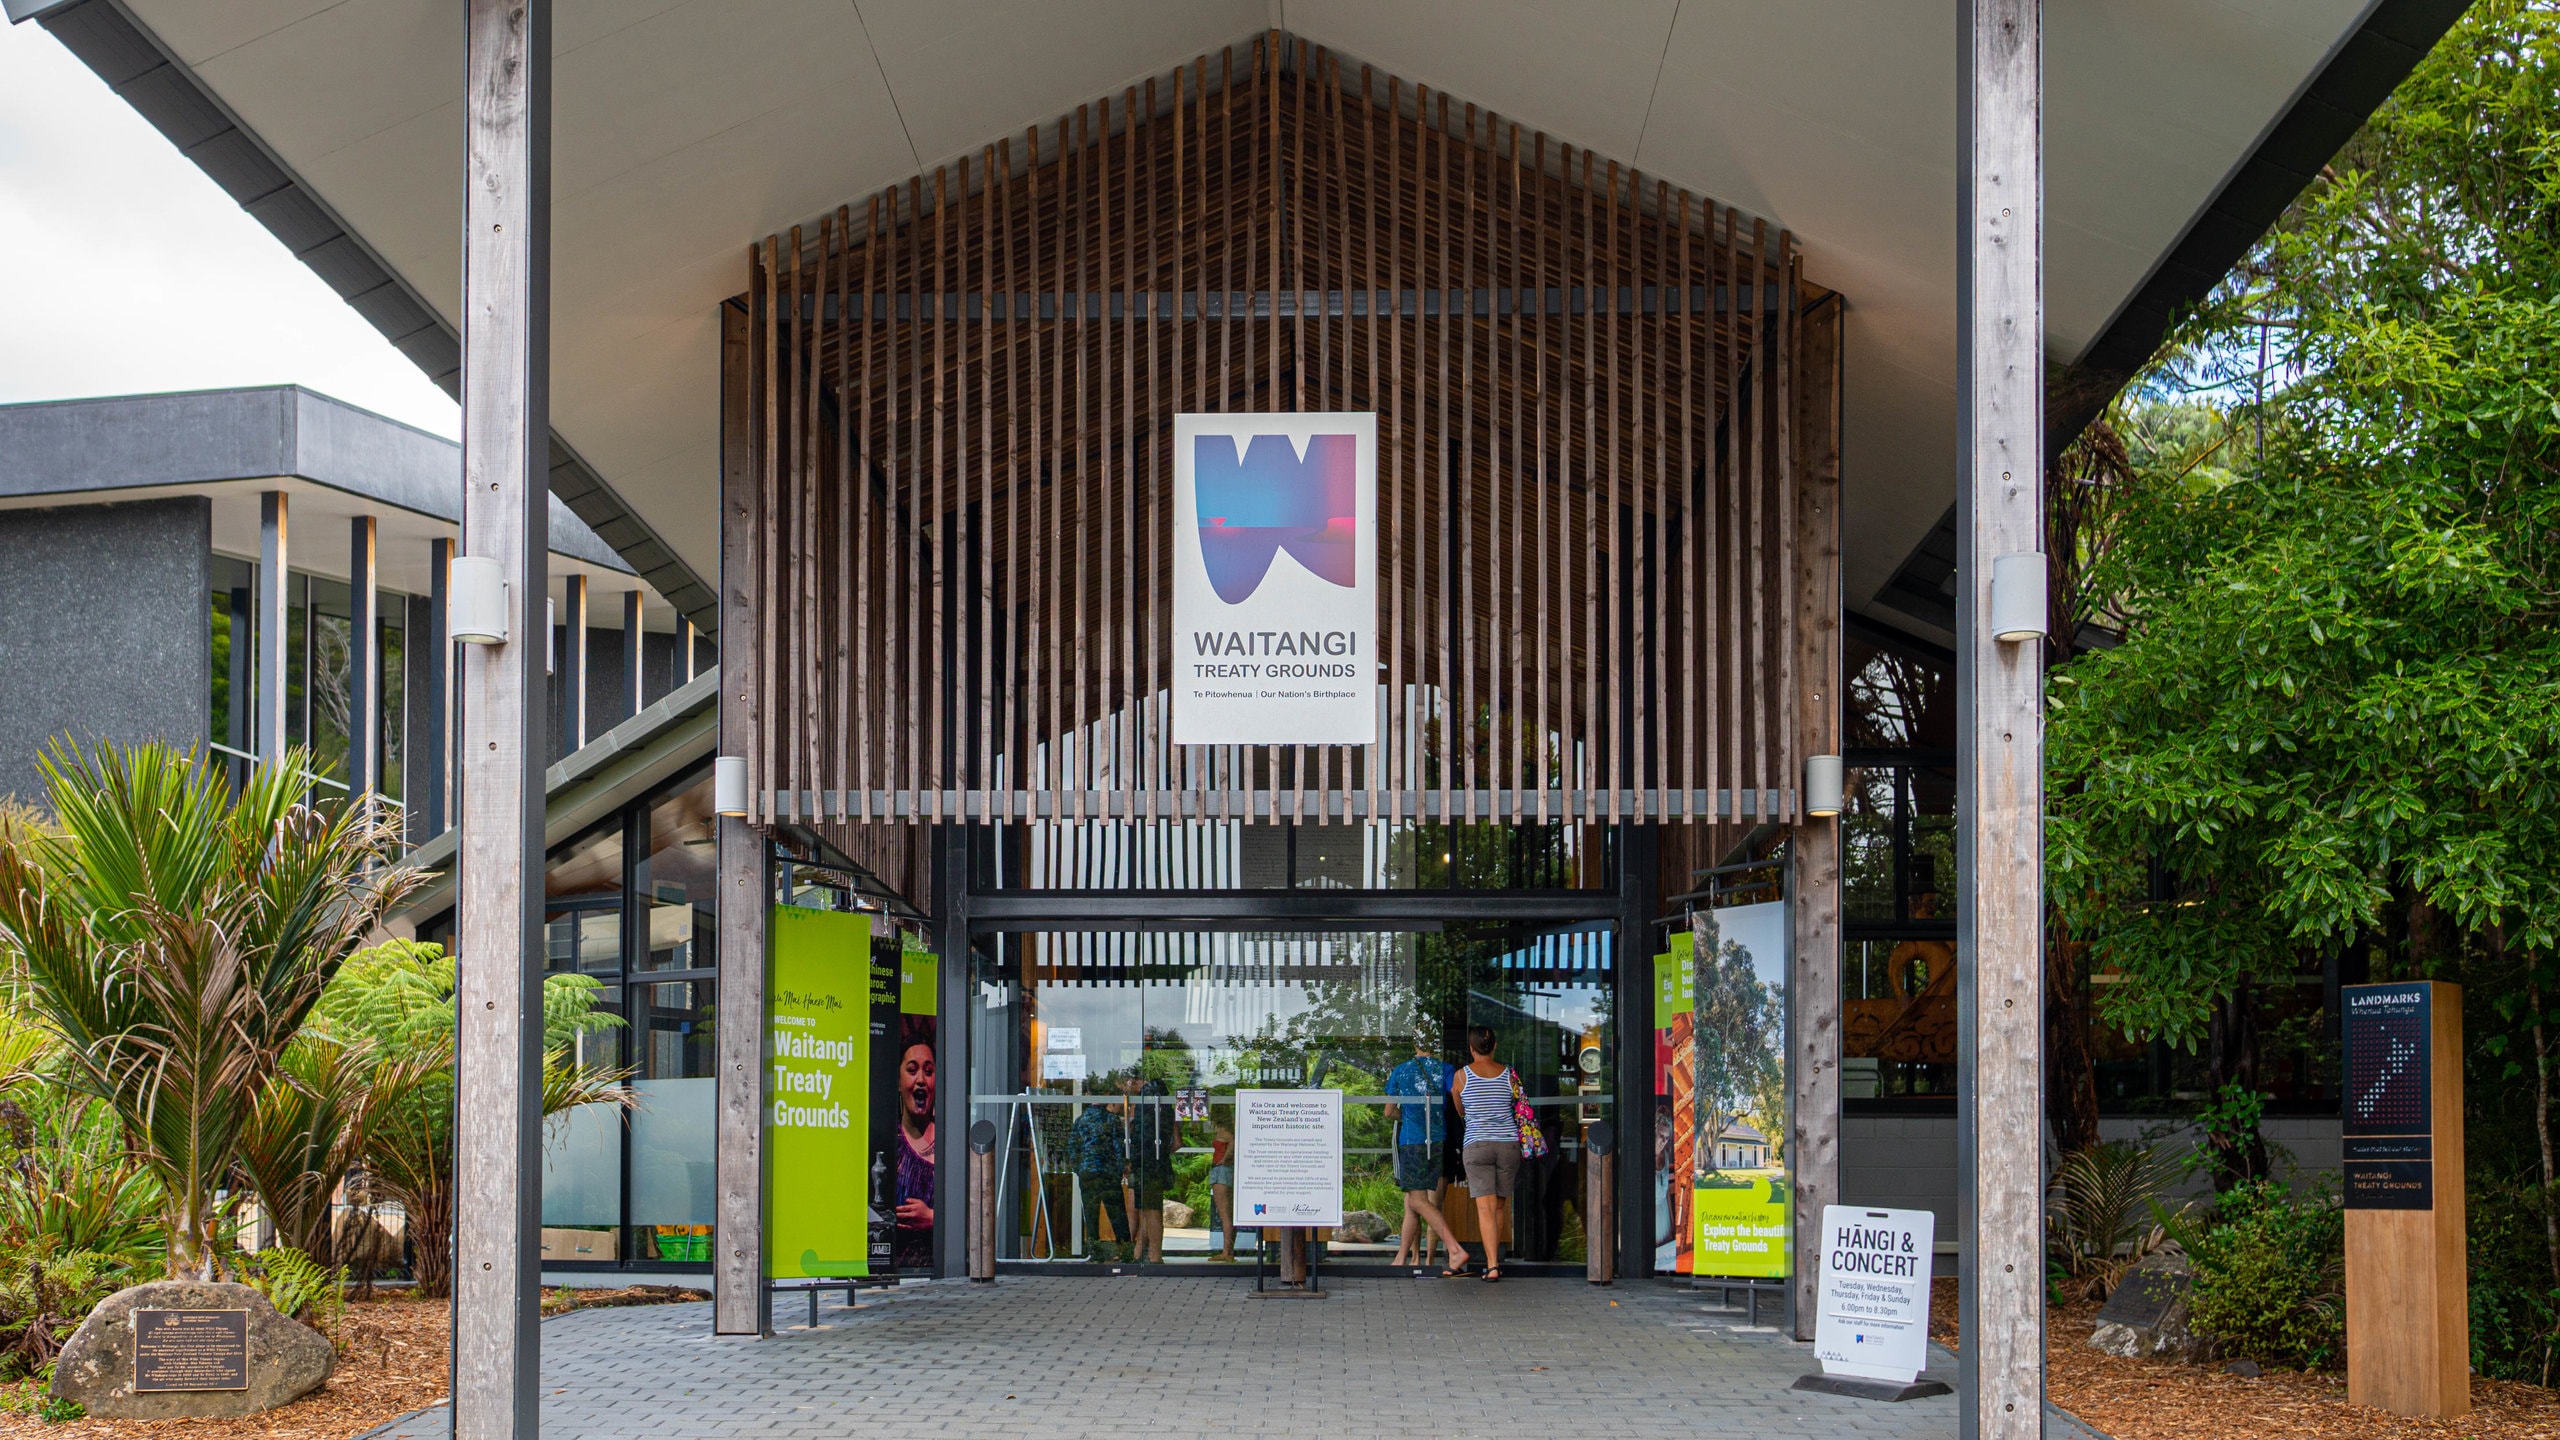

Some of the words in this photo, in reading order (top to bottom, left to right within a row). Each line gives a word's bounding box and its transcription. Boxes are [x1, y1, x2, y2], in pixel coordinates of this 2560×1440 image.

[1193, 631, 1356, 656] WAITANGI
[1193, 663, 1261, 678] TREATY
[1265, 663, 1355, 678] GROUNDS
[1193, 690, 1203, 698] Te
[1205, 690, 1253, 698] Pitowhenua
[1260, 690, 1276, 698] Our
[1278, 690, 1311, 698] Nation's
[1313, 690, 1356, 700] Birthplace
[2351, 992, 2421, 1006] LANDMARKS
[774, 1014, 806, 1026] WELCOME
[807, 1017, 816, 1027] TO
[774, 1030, 853, 1067] Waitangi
[774, 1065, 833, 1101] Treaty
[774, 1099, 850, 1129] Grounds
[2353, 1172, 2392, 1180] WAITANGI
[2383, 1181, 2422, 1189] GROUNDS
[1703, 1223, 1735, 1239] Explore
[1736, 1223, 1751, 1237] the
[1837, 1224, 1895, 1251] HĀNGI
[1901, 1231, 1914, 1253] &
[1704, 1238, 1731, 1255] Treaty
[1732, 1239, 1769, 1253] Grounds
[1832, 1250, 1919, 1277] CONCERT
[1839, 1280, 1865, 1292] Tuesday,
[1866, 1282, 1904, 1295] Wednesday,
[1831, 1289, 1860, 1301] Thursday,
[1861, 1292, 1880, 1303] Friday
[1881, 1294, 1886, 1302] &
[1887, 1294, 1911, 1307] Sunday
[1841, 1302, 1865, 1313] 6.00pm
[1866, 1305, 1873, 1313] to
[1873, 1305, 1898, 1316] 8.30pm
